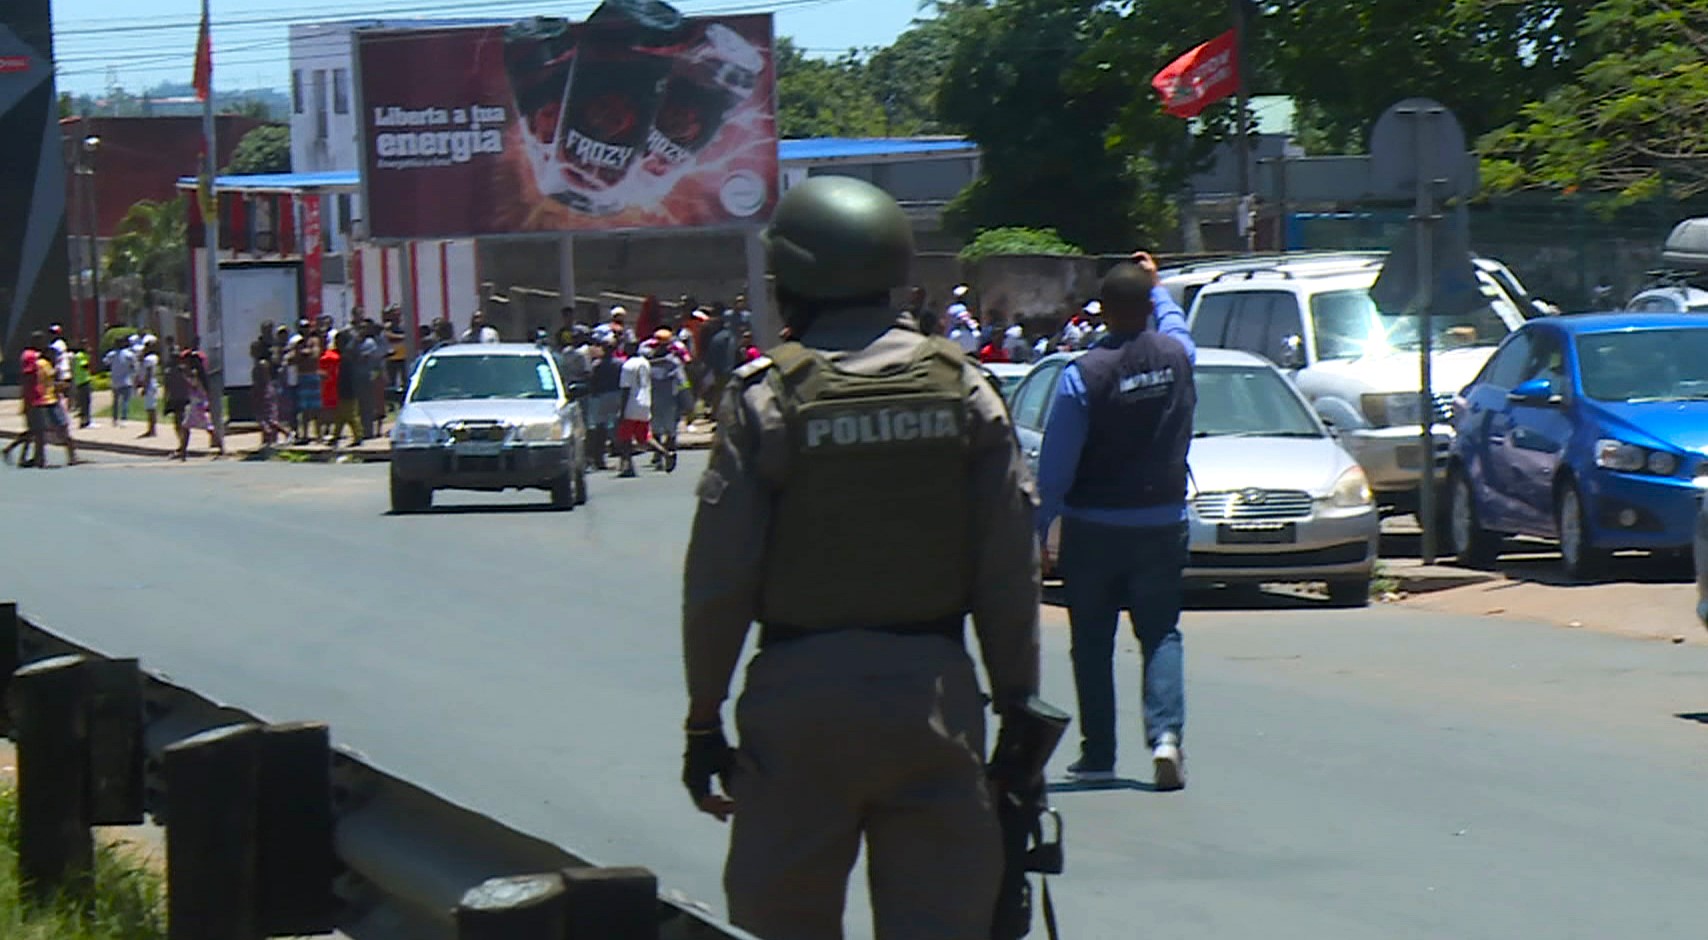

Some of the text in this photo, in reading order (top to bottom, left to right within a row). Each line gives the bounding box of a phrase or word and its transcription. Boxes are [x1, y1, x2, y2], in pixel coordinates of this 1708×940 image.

[374, 105, 505, 126] Liberta a tua
[377, 123, 502, 163] energia
[566, 128, 634, 169] FROZY
[647, 127, 691, 161] ROZY
[807, 408, 959, 448] POLÍCIA
